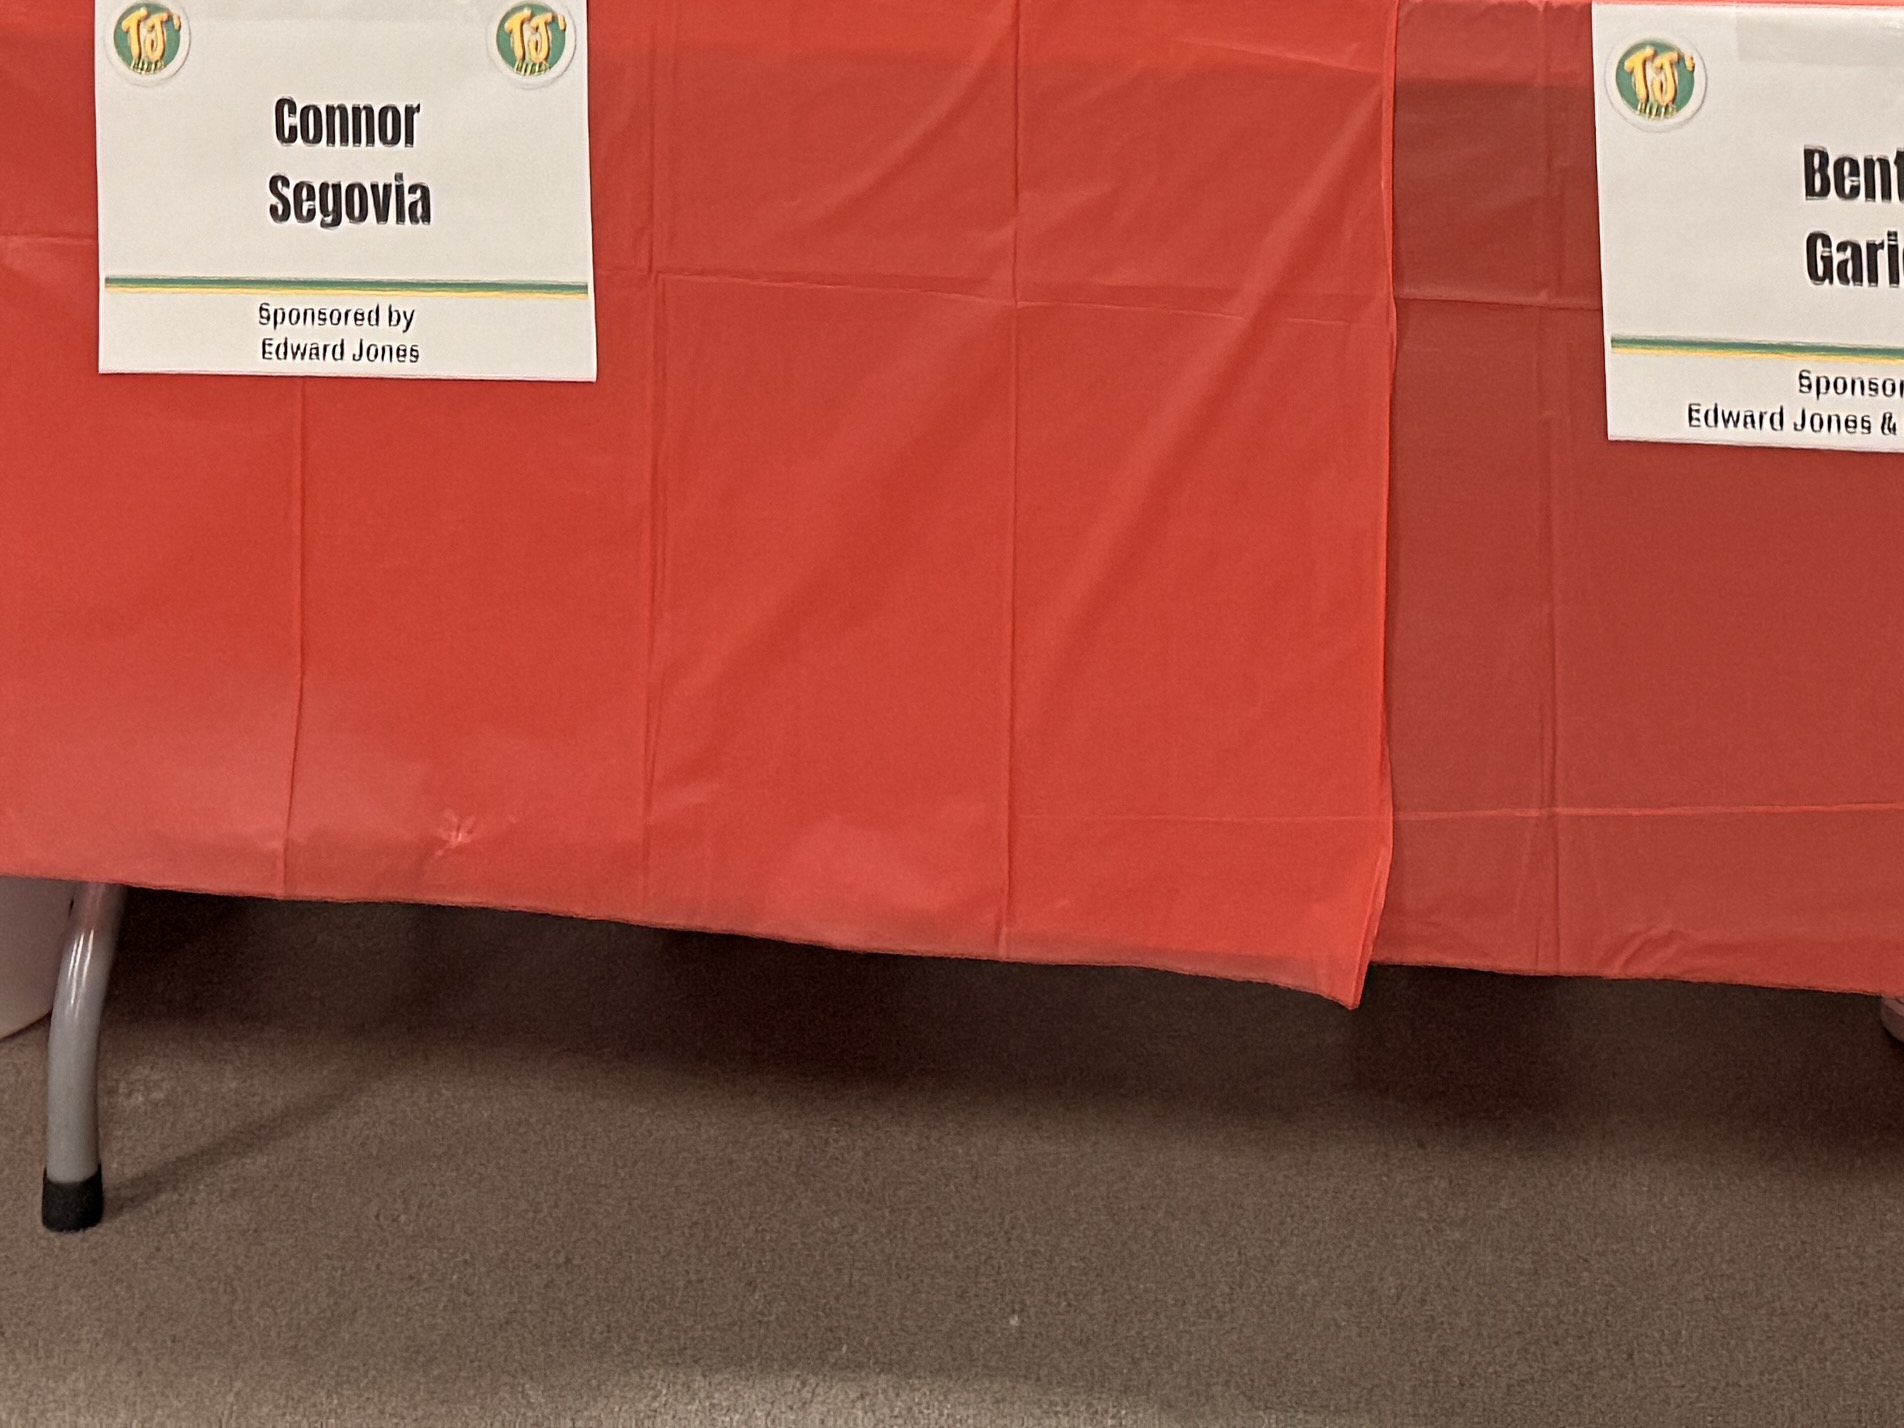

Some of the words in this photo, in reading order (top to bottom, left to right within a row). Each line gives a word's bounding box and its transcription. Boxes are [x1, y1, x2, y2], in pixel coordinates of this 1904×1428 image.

[274, 96, 420, 148] Connor
[268, 172, 431, 230] Segovia
[258, 302, 379, 331] Sponsored
[387, 304, 415, 333] by
[261, 337, 343, 363] Edward
[351, 338, 421, 364] Jones
[1688, 403, 1784, 432] Edward
[1793, 408, 1872, 436] Jones
[1879, 411, 1896, 436] &
